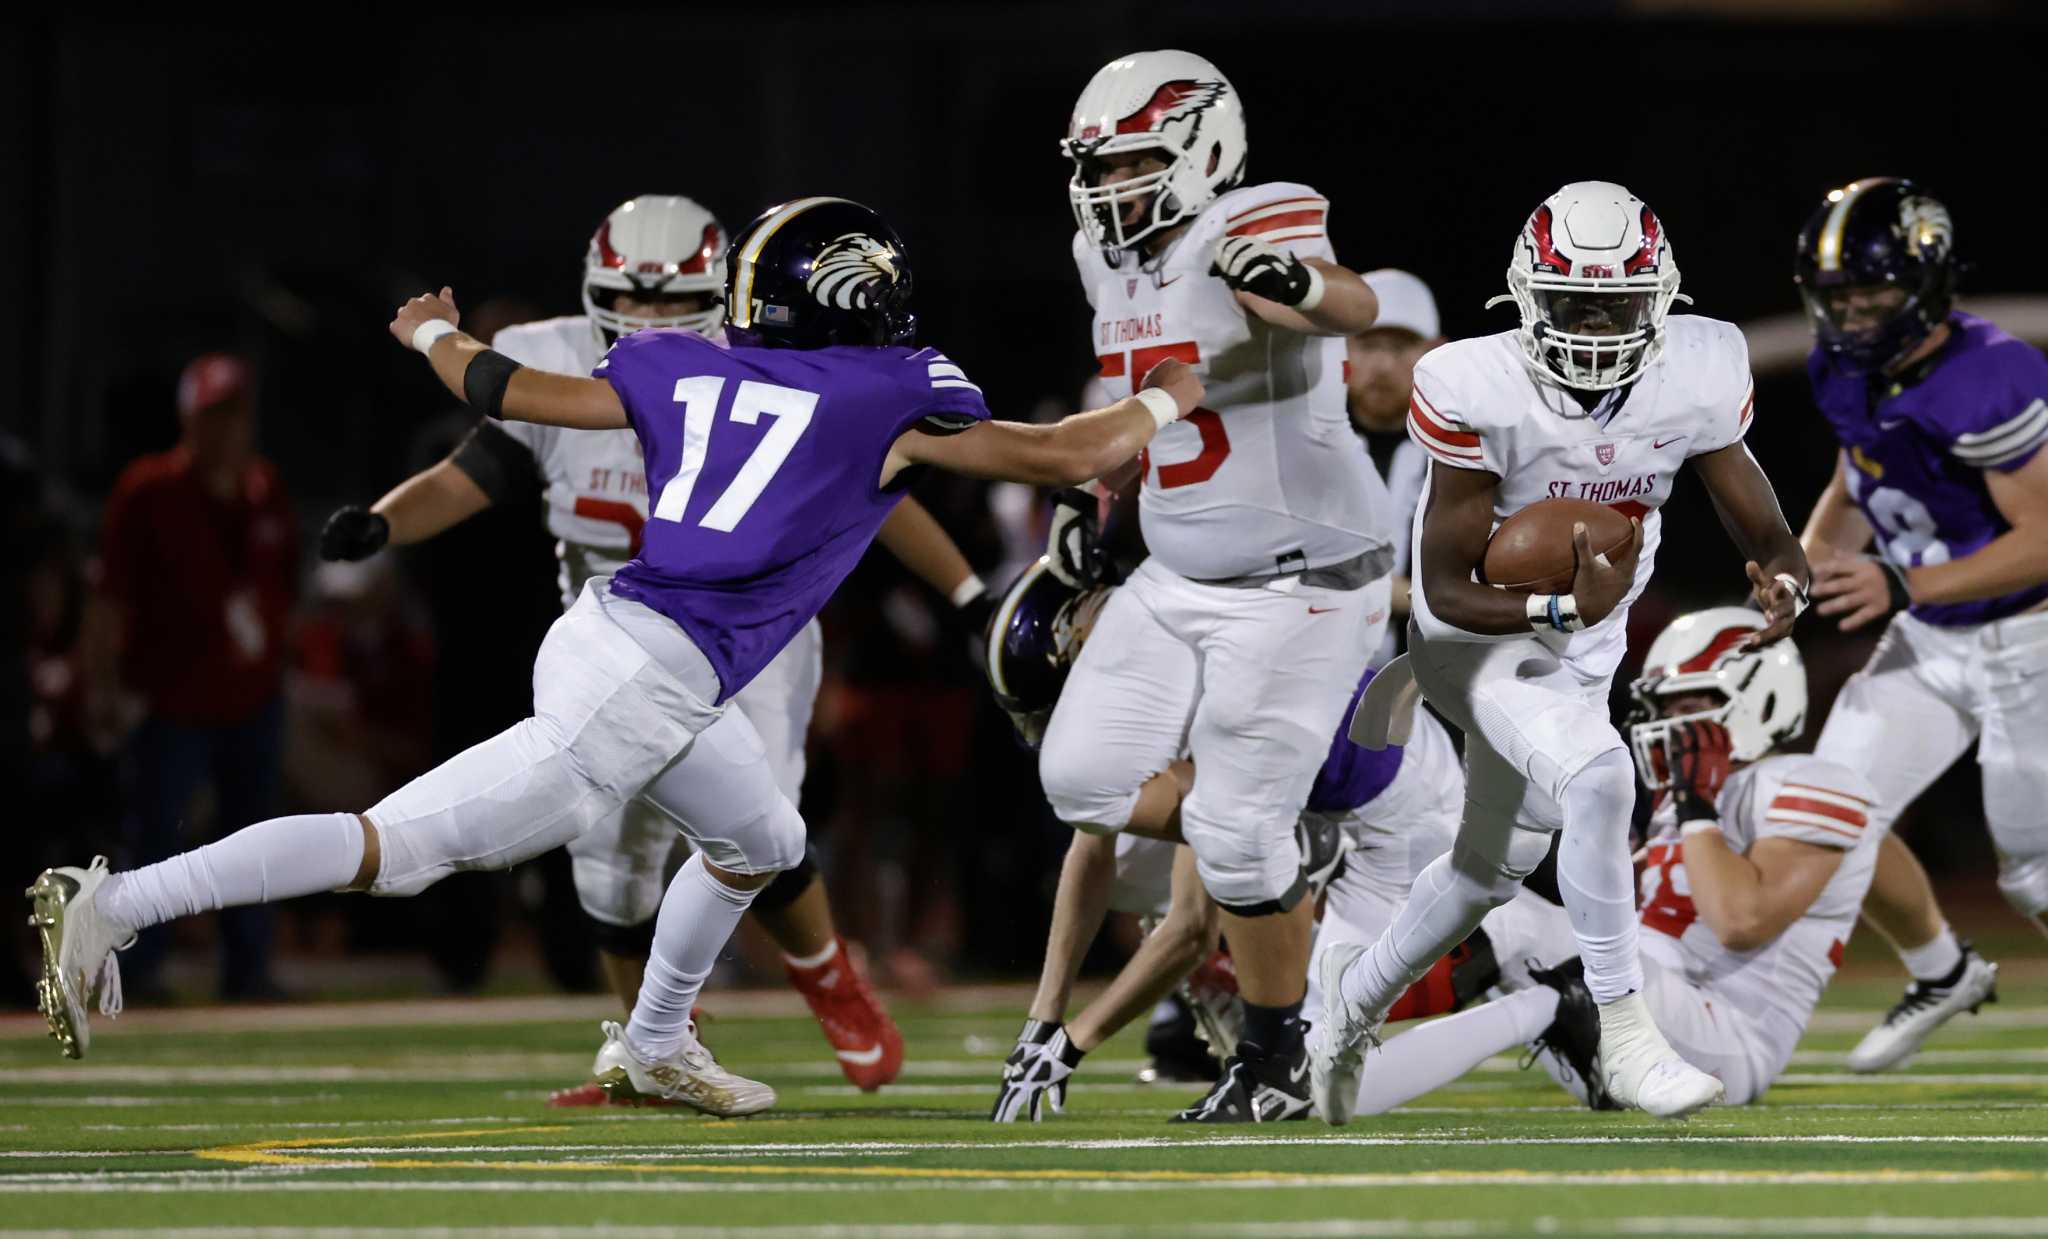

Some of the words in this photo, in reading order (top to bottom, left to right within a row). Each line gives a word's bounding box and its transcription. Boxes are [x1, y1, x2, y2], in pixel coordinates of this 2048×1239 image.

[1114, 313, 1163, 344] THOMAS
[653, 375, 821, 533] 17
[1545, 480, 1572, 499] ST
[1579, 473, 1657, 502] THOMAS
